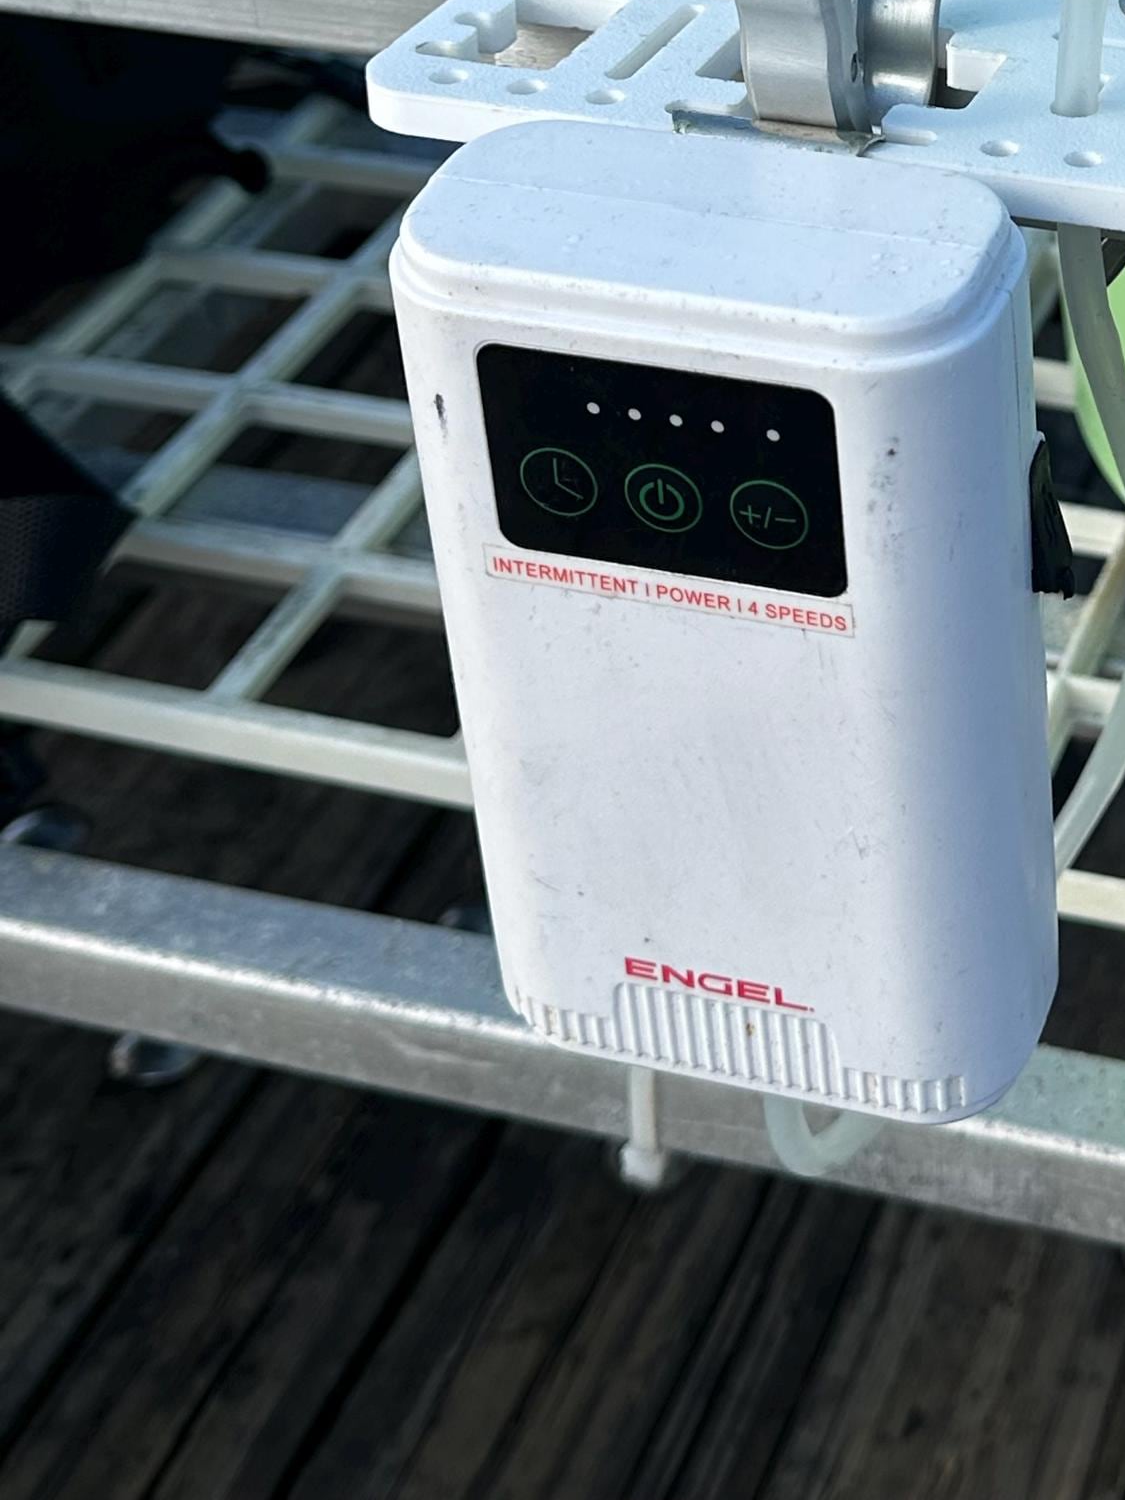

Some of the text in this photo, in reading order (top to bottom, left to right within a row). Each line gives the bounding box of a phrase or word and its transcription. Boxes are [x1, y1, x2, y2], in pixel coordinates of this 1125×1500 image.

[493, 556, 639, 596] INTERMITTENT
[655, 584, 731, 611] POWER
[747, 601, 761, 617] 4
[765, 604, 848, 631] SPEEDS
[624, 957, 811, 1012] ENGEL
